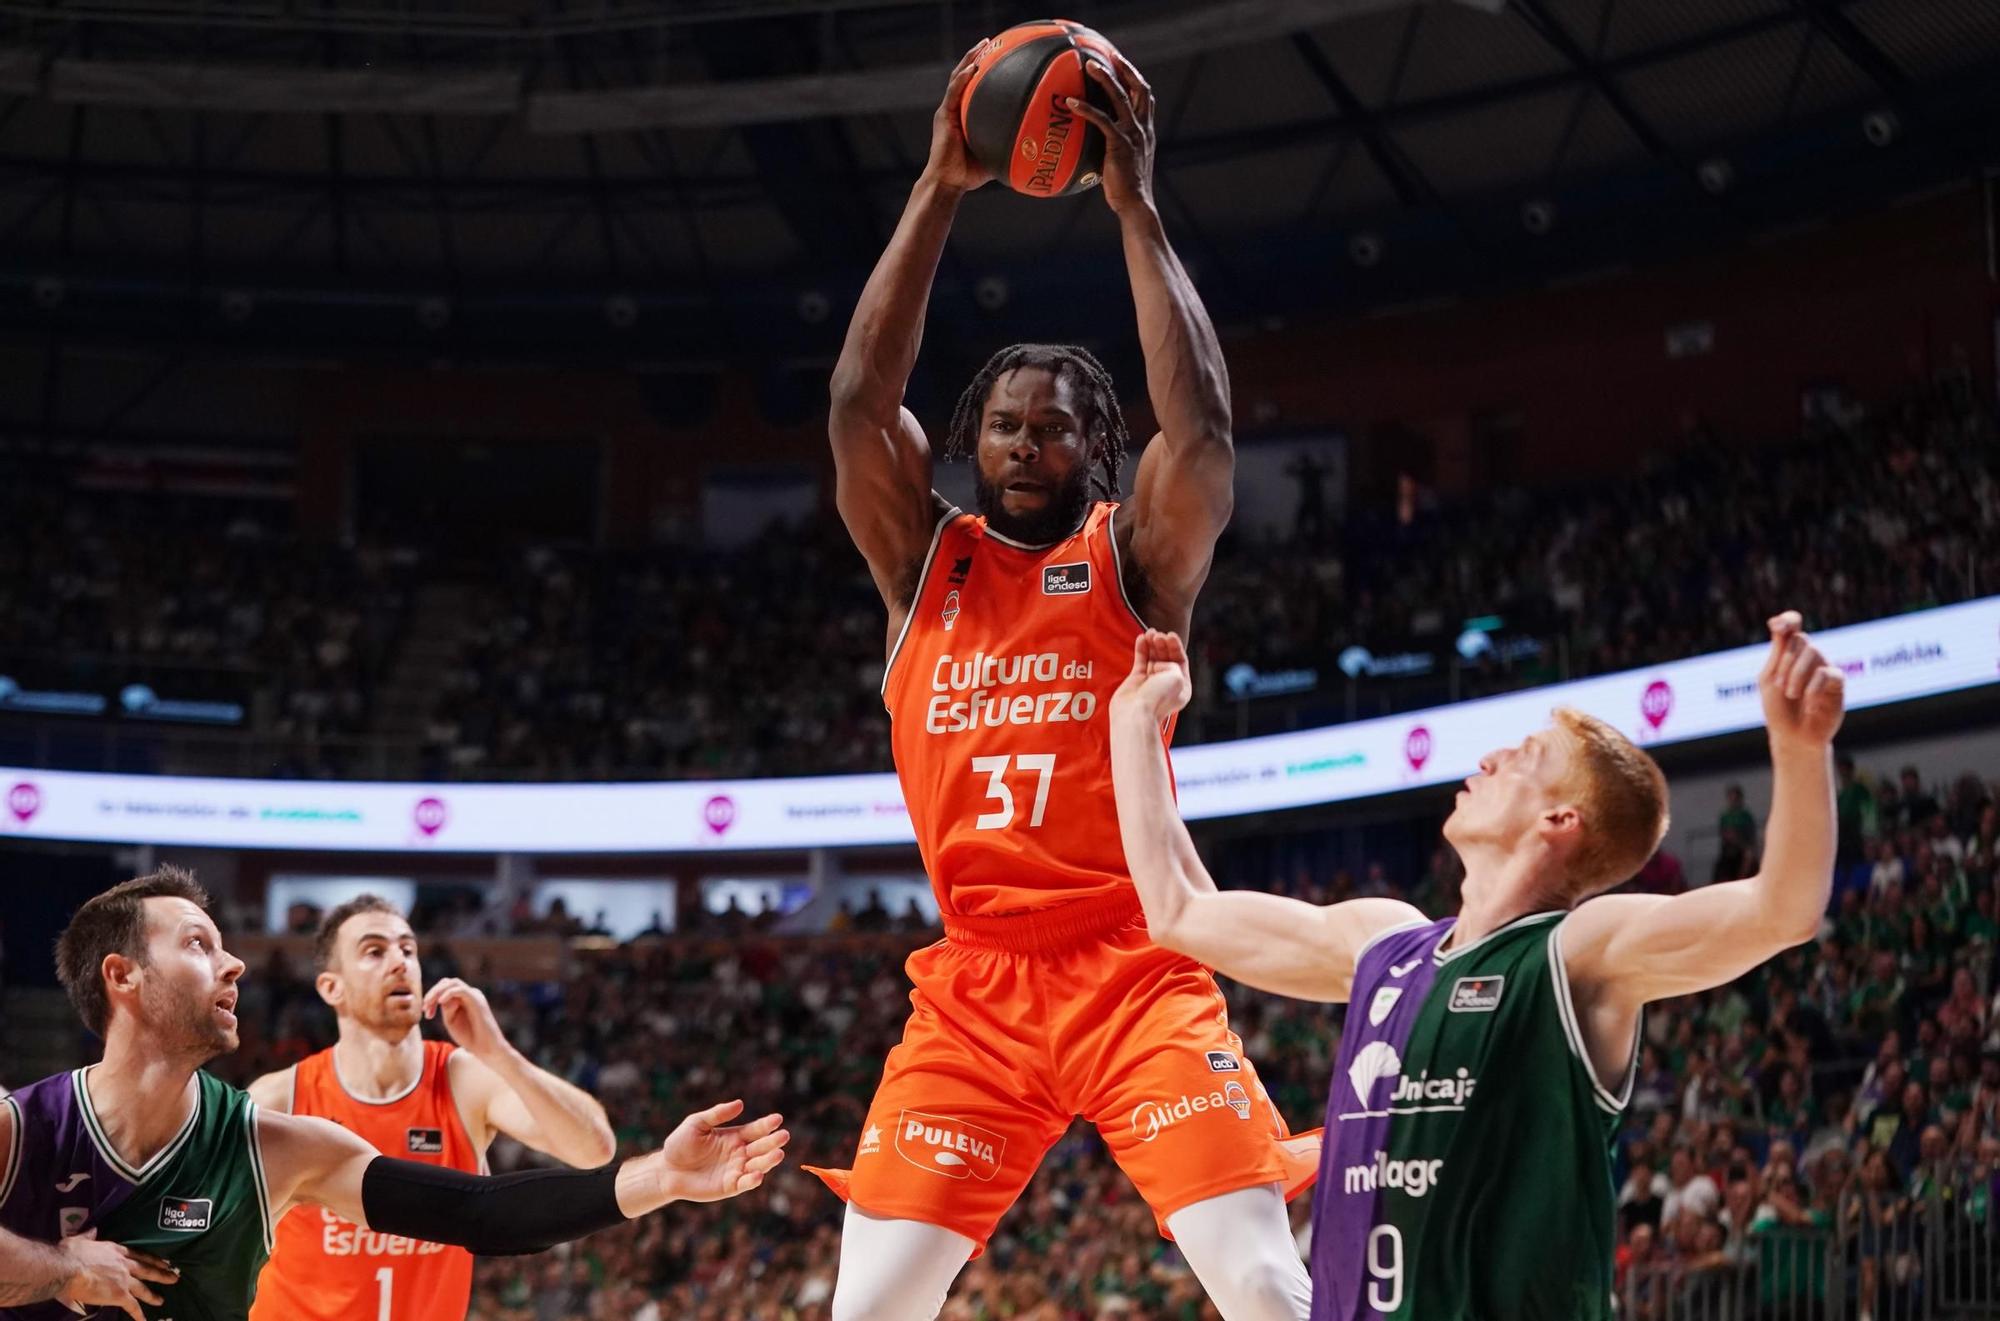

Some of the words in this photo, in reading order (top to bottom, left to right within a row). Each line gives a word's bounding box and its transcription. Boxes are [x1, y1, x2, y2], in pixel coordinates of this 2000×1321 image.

[1047, 574, 1067, 585] liga
[1047, 581, 1088, 591] endesa
[932, 652, 1060, 692] Cultura
[1062, 659, 1094, 680] del
[926, 690, 1097, 735] Esfuerzo
[971, 753, 1057, 830] 37
[1212, 1059, 1234, 1070] acb
[1131, 1091, 1226, 1142] Midea
[904, 1119, 995, 1165] PULEVA
[164, 1206, 186, 1219] liga
[1368, 1223, 1404, 1313] 9
[374, 1266, 394, 1321] 1
